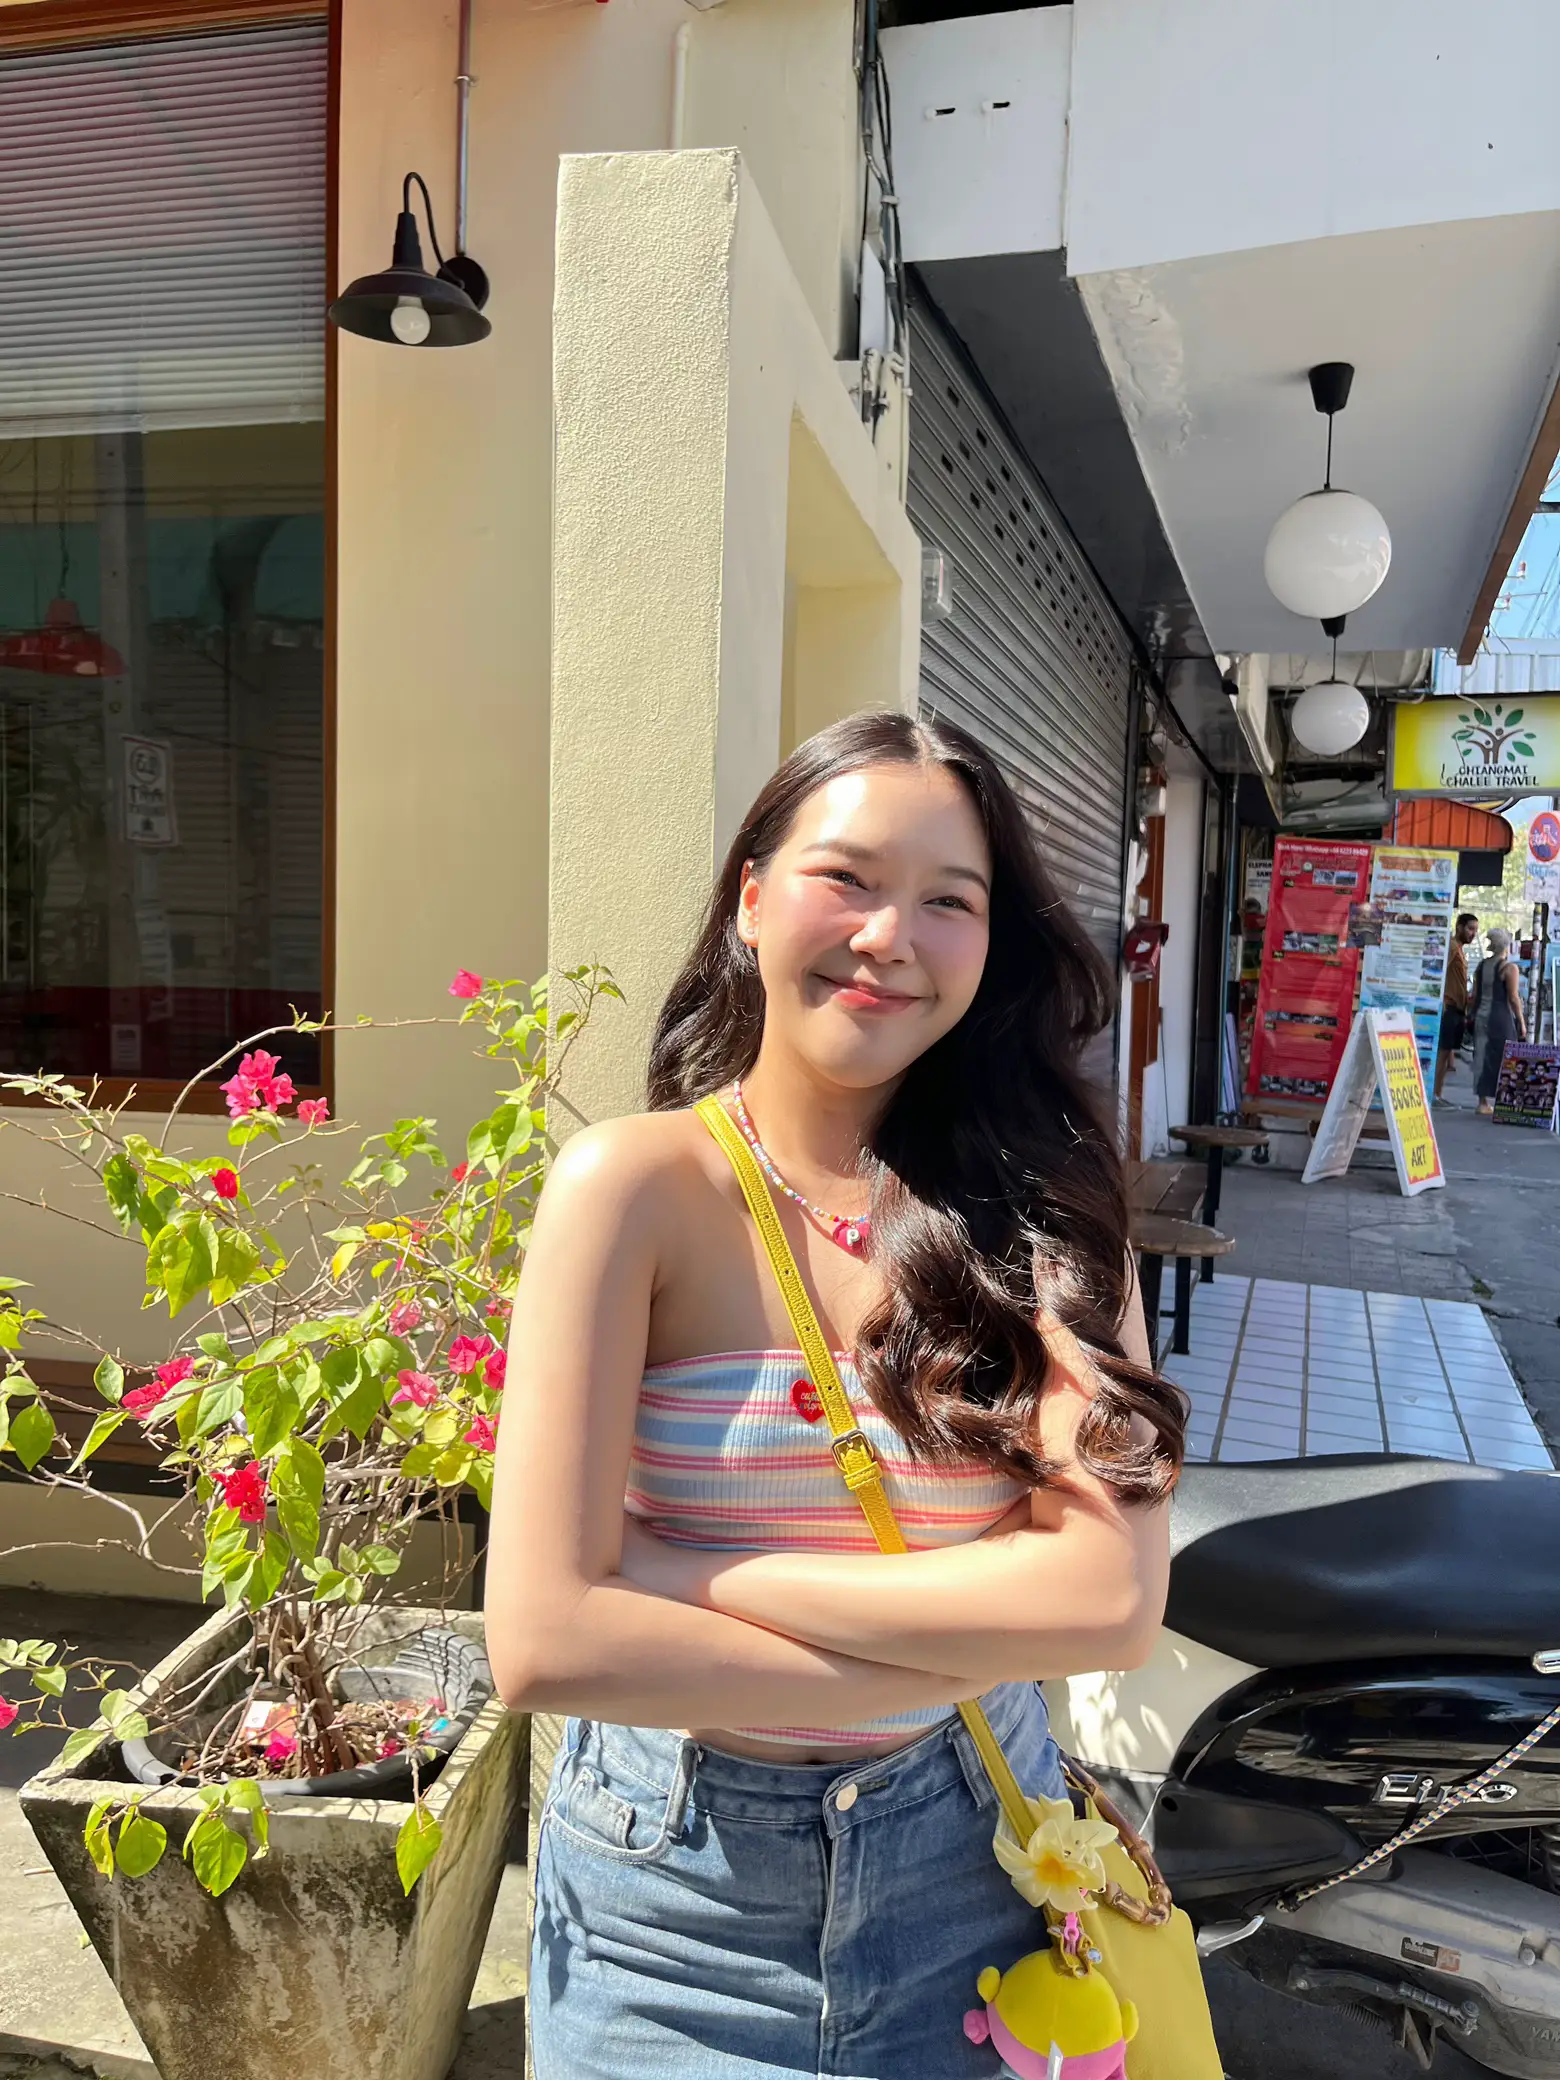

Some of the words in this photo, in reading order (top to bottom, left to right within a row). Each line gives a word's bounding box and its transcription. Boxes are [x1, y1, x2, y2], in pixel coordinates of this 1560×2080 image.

[1495, 775, 1539, 787] TRAVEL
[1389, 1084, 1422, 1112] BOOKS
[1411, 1144, 1427, 1167] ART
